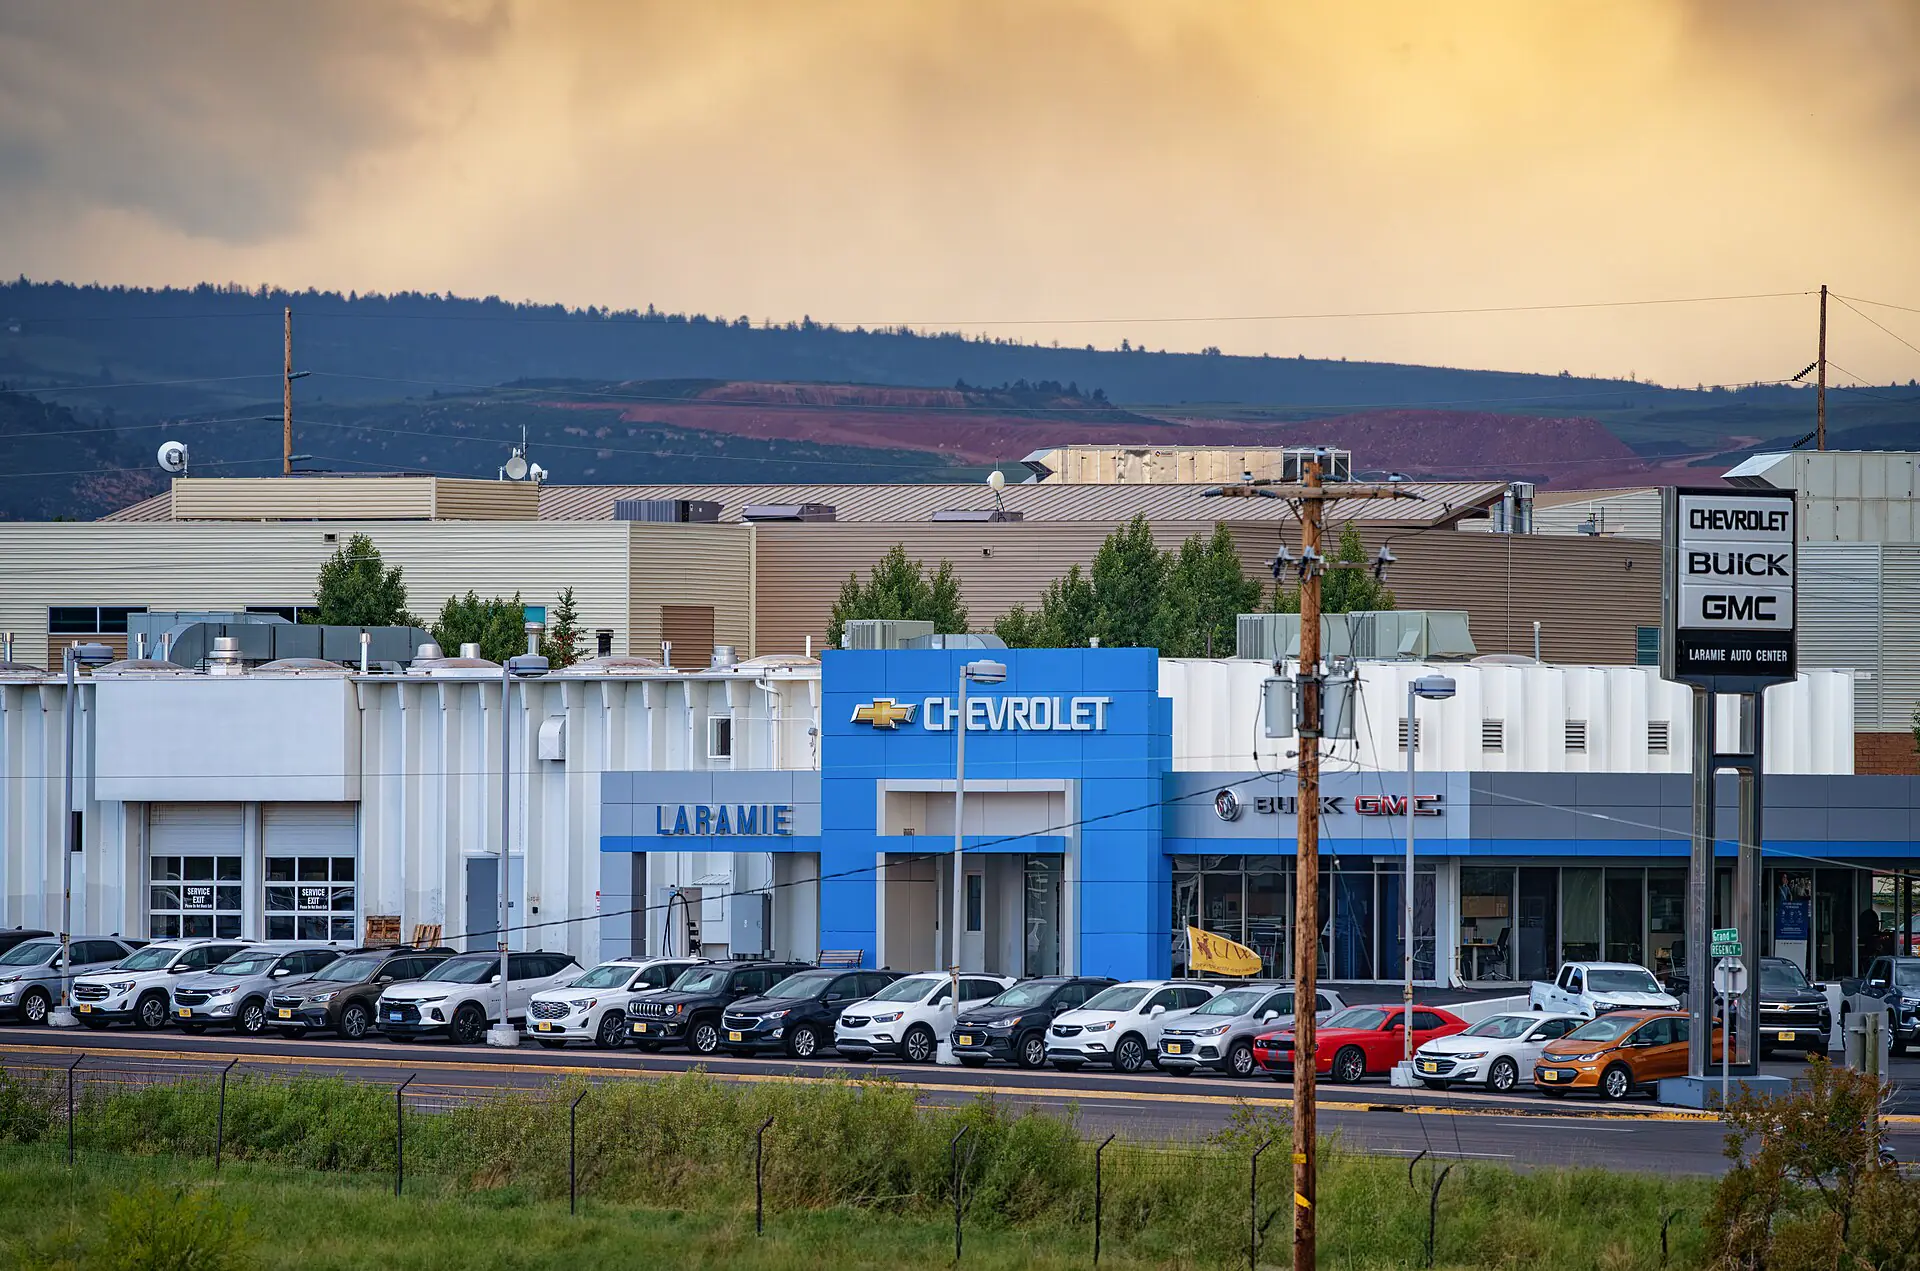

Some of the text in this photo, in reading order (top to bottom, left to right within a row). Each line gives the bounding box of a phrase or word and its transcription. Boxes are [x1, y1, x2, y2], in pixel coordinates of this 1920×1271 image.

[1690, 508, 1789, 531] CHEVROLET
[1688, 552, 1789, 576] BUICK
[1702, 595, 1776, 620] GMC
[1689, 648, 1788, 662] LARAMIE AUTO CENTER
[923, 696, 1113, 731] CHEVROLET
[1253, 794, 1444, 816] BUIK GMC
[656, 804, 792, 836] LARAMIE
[302, 888, 325, 896] SERVICE
[1713, 931, 1730, 941] Grand
[1712, 945, 1736, 954] REGENCY
